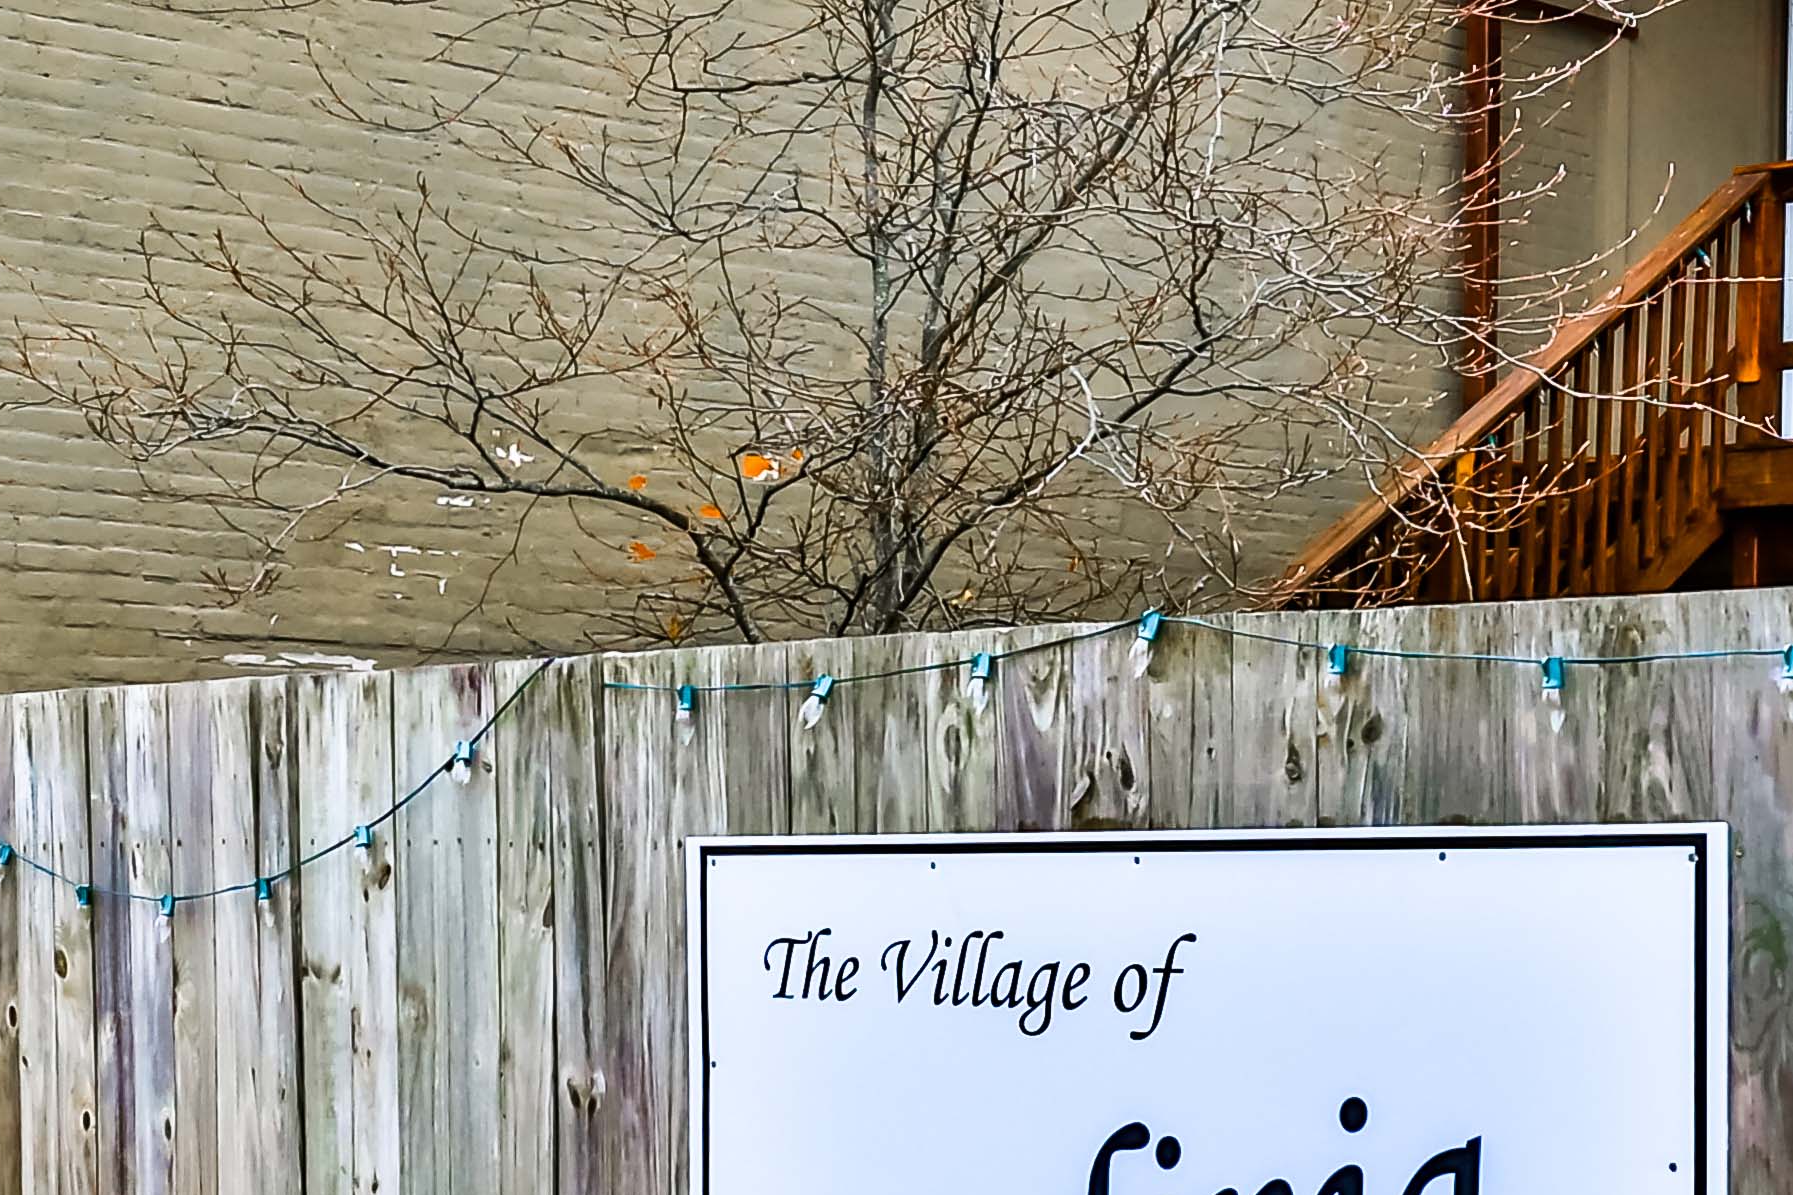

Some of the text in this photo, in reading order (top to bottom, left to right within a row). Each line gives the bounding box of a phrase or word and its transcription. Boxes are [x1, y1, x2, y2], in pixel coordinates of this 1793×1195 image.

[762, 928, 1198, 1041] The Village of
